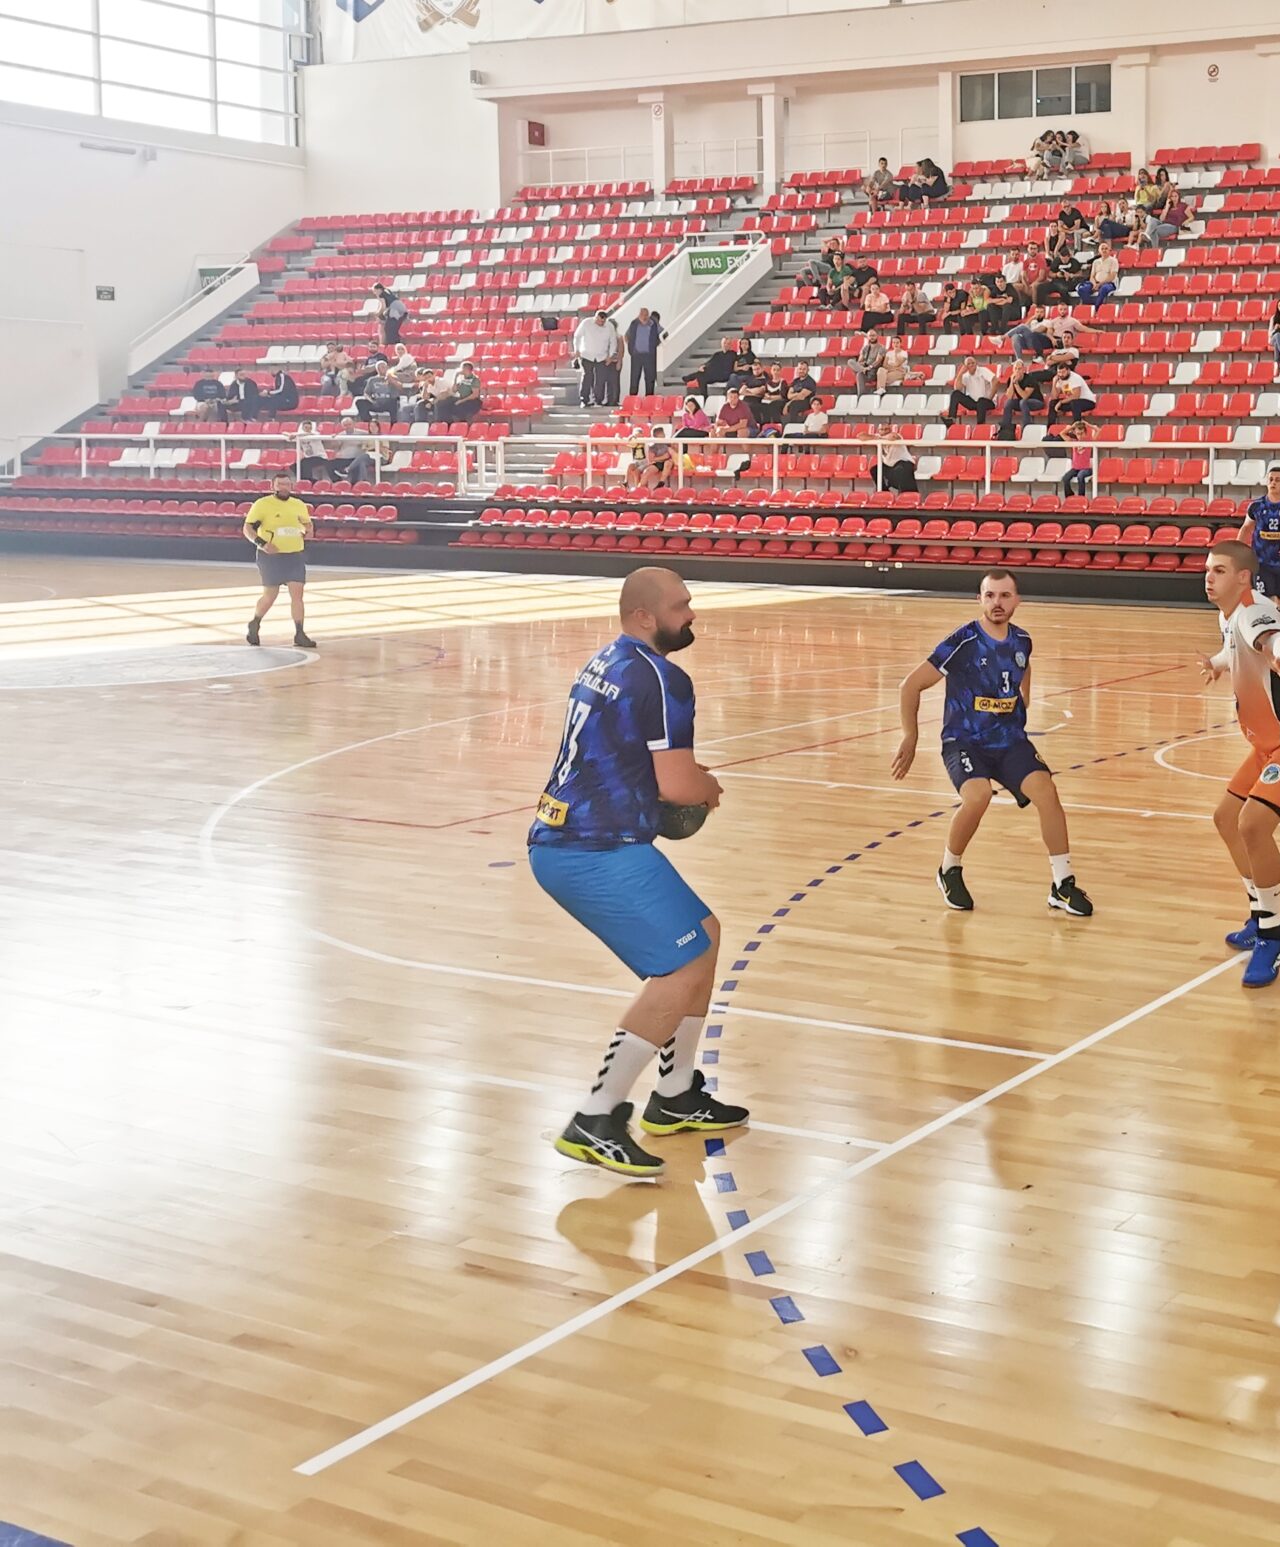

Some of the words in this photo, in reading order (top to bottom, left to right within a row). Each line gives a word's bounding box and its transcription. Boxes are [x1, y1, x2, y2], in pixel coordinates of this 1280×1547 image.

[692, 257, 721, 269] ИЗЛАЗ
[1268, 518, 1279, 530] 22
[1002, 671, 1010, 694] 3
[961, 756, 974, 773] 3
